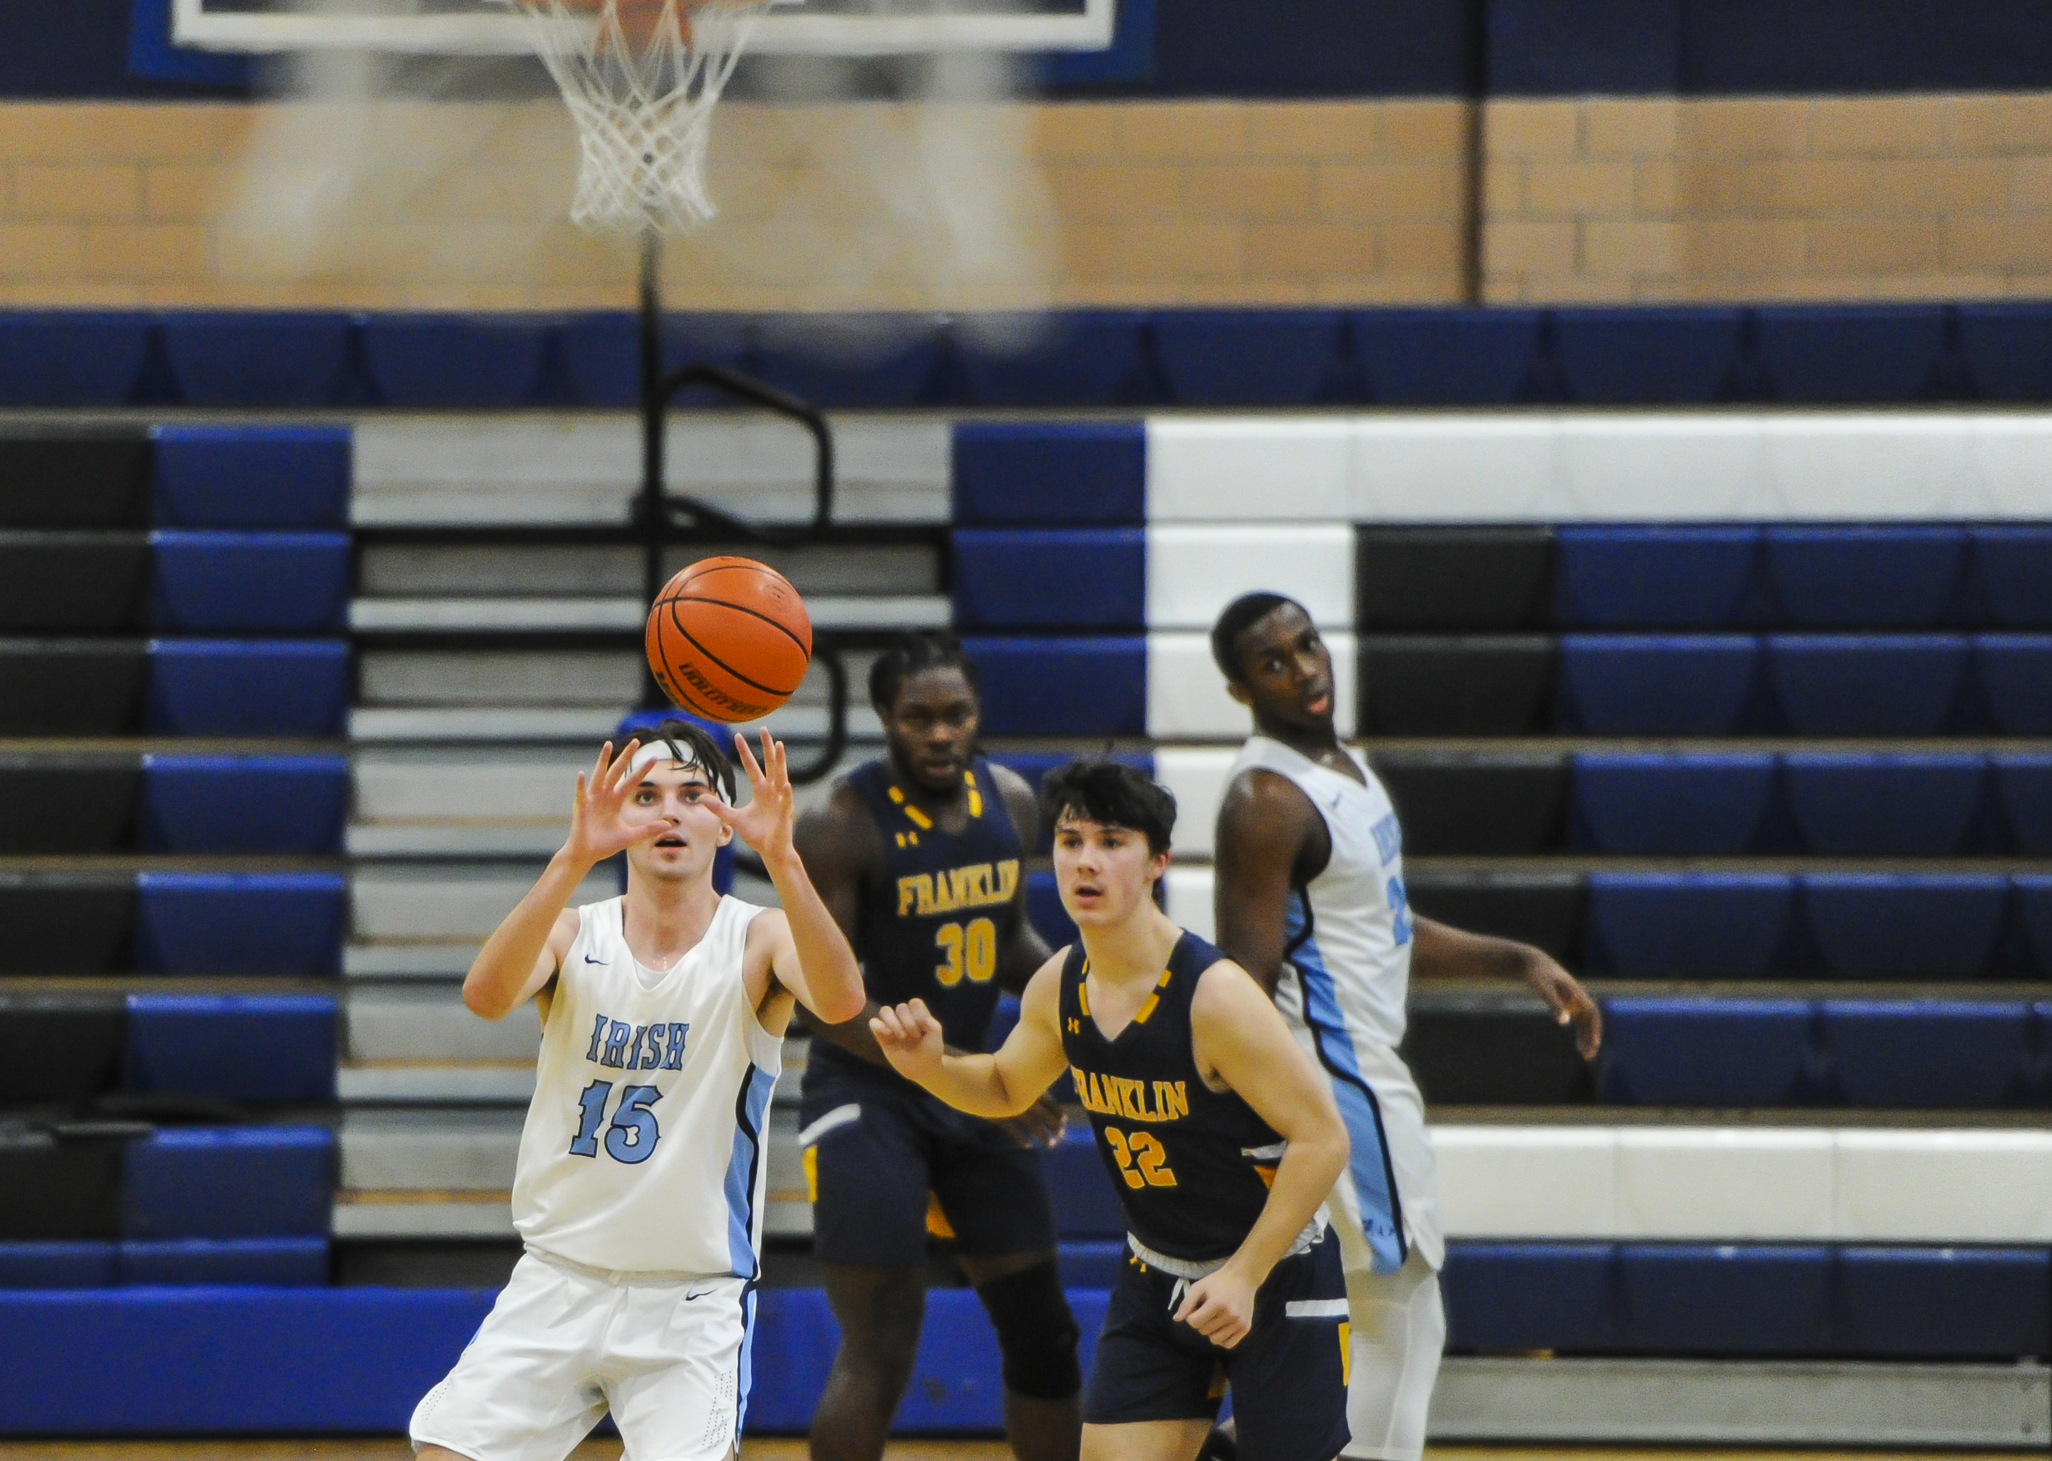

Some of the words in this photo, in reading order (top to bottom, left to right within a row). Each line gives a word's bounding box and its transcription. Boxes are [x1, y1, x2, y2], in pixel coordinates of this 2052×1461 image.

[935, 917, 996, 986] 30
[586, 1013, 690, 1071] IRISH
[569, 1078, 664, 1165] 15
[1070, 1064, 1189, 1122] RANKLIN
[1105, 1126, 1178, 1189] 22
